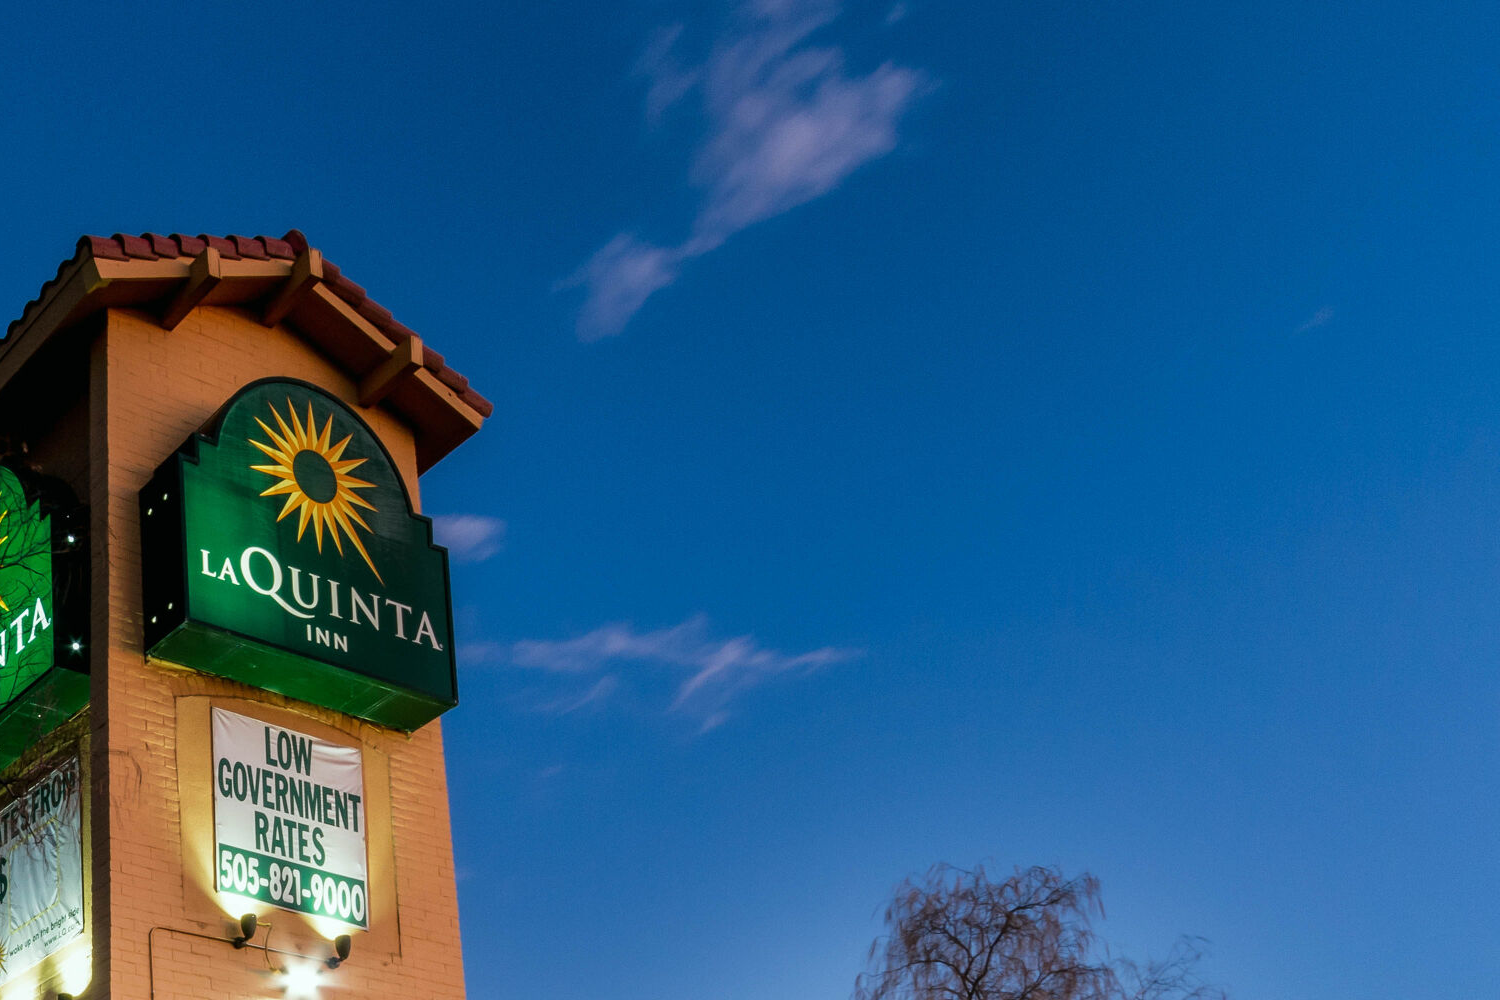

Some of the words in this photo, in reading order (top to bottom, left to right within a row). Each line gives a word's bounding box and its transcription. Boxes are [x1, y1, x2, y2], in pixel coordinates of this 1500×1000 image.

[307, 624, 348, 653] INN
[265, 726, 312, 776] LOW
[218, 757, 361, 833] GOVERNMENT
[254, 811, 326, 866] RATES
[220, 850, 364, 922] 505-821-9000
[32, 933, 40, 942] on
